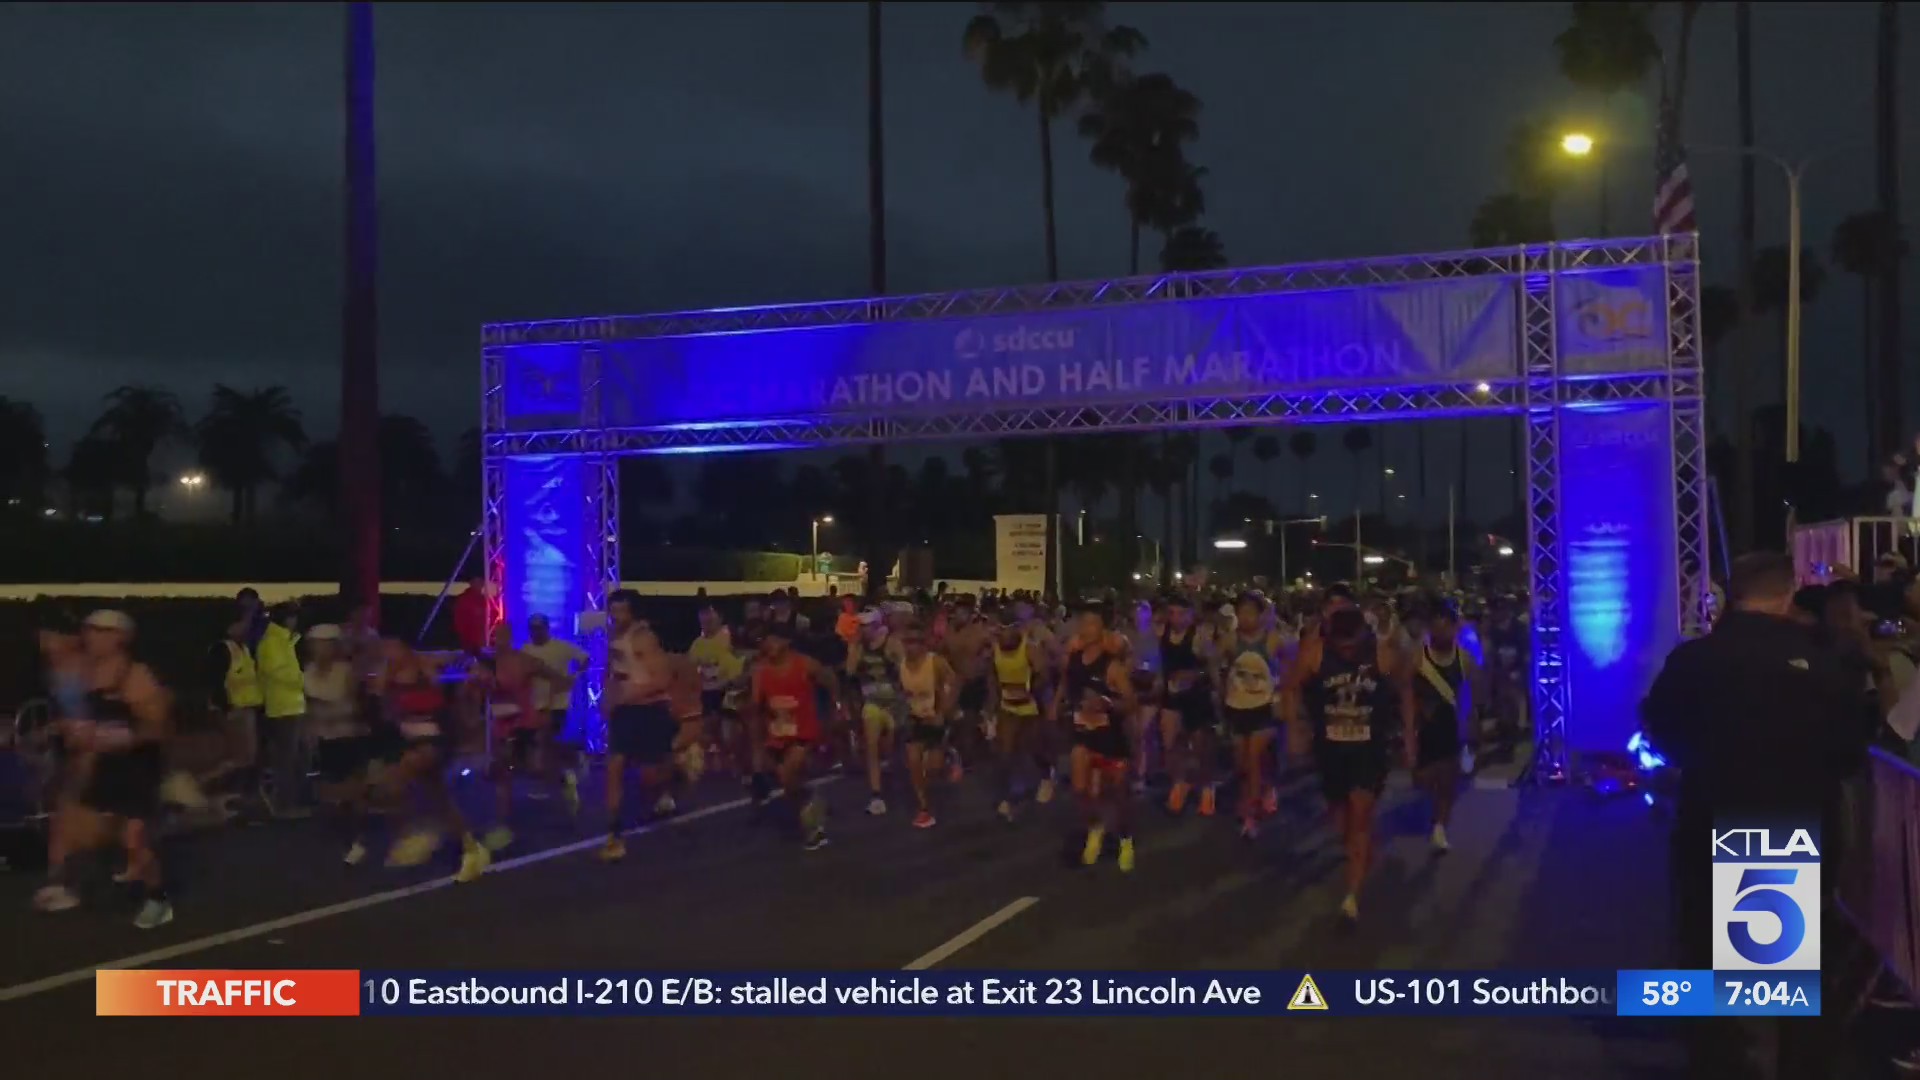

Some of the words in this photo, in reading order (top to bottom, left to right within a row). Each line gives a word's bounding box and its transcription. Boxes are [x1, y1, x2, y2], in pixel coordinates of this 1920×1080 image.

[993, 325, 1074, 352] sdccu
[966, 365, 1045, 397] AND
[1059, 356, 1150, 393] HALF
[1163, 340, 1400, 385] MARATHON
